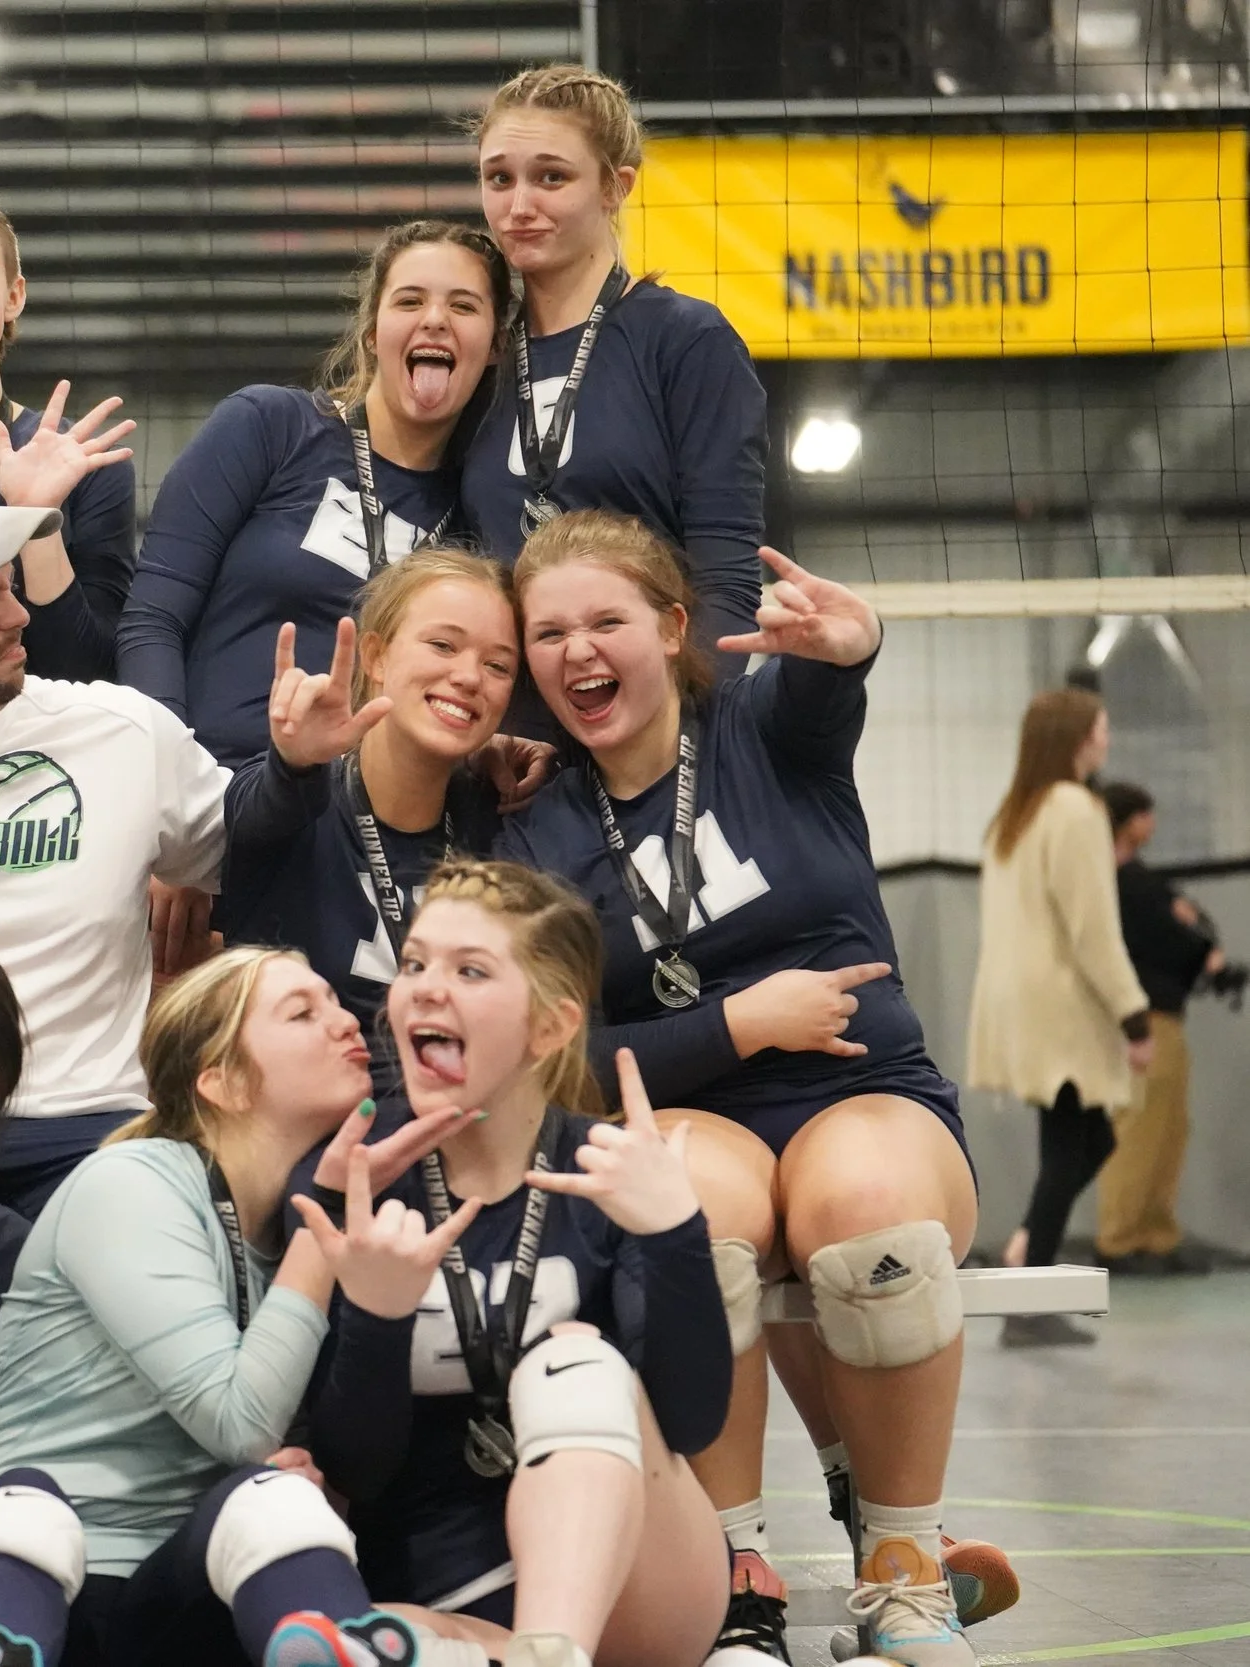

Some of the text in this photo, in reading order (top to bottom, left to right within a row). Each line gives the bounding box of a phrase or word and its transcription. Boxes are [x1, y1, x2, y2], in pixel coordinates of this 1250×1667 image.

[786, 245, 1050, 312] NASHBIRD
[567, 303, 607, 390] RUNNER-UP
[352, 428, 378, 516] RUNNER-UP
[676, 734, 697, 837] RUNNER-UP
[357, 813, 403, 922] RUNNER-UP
